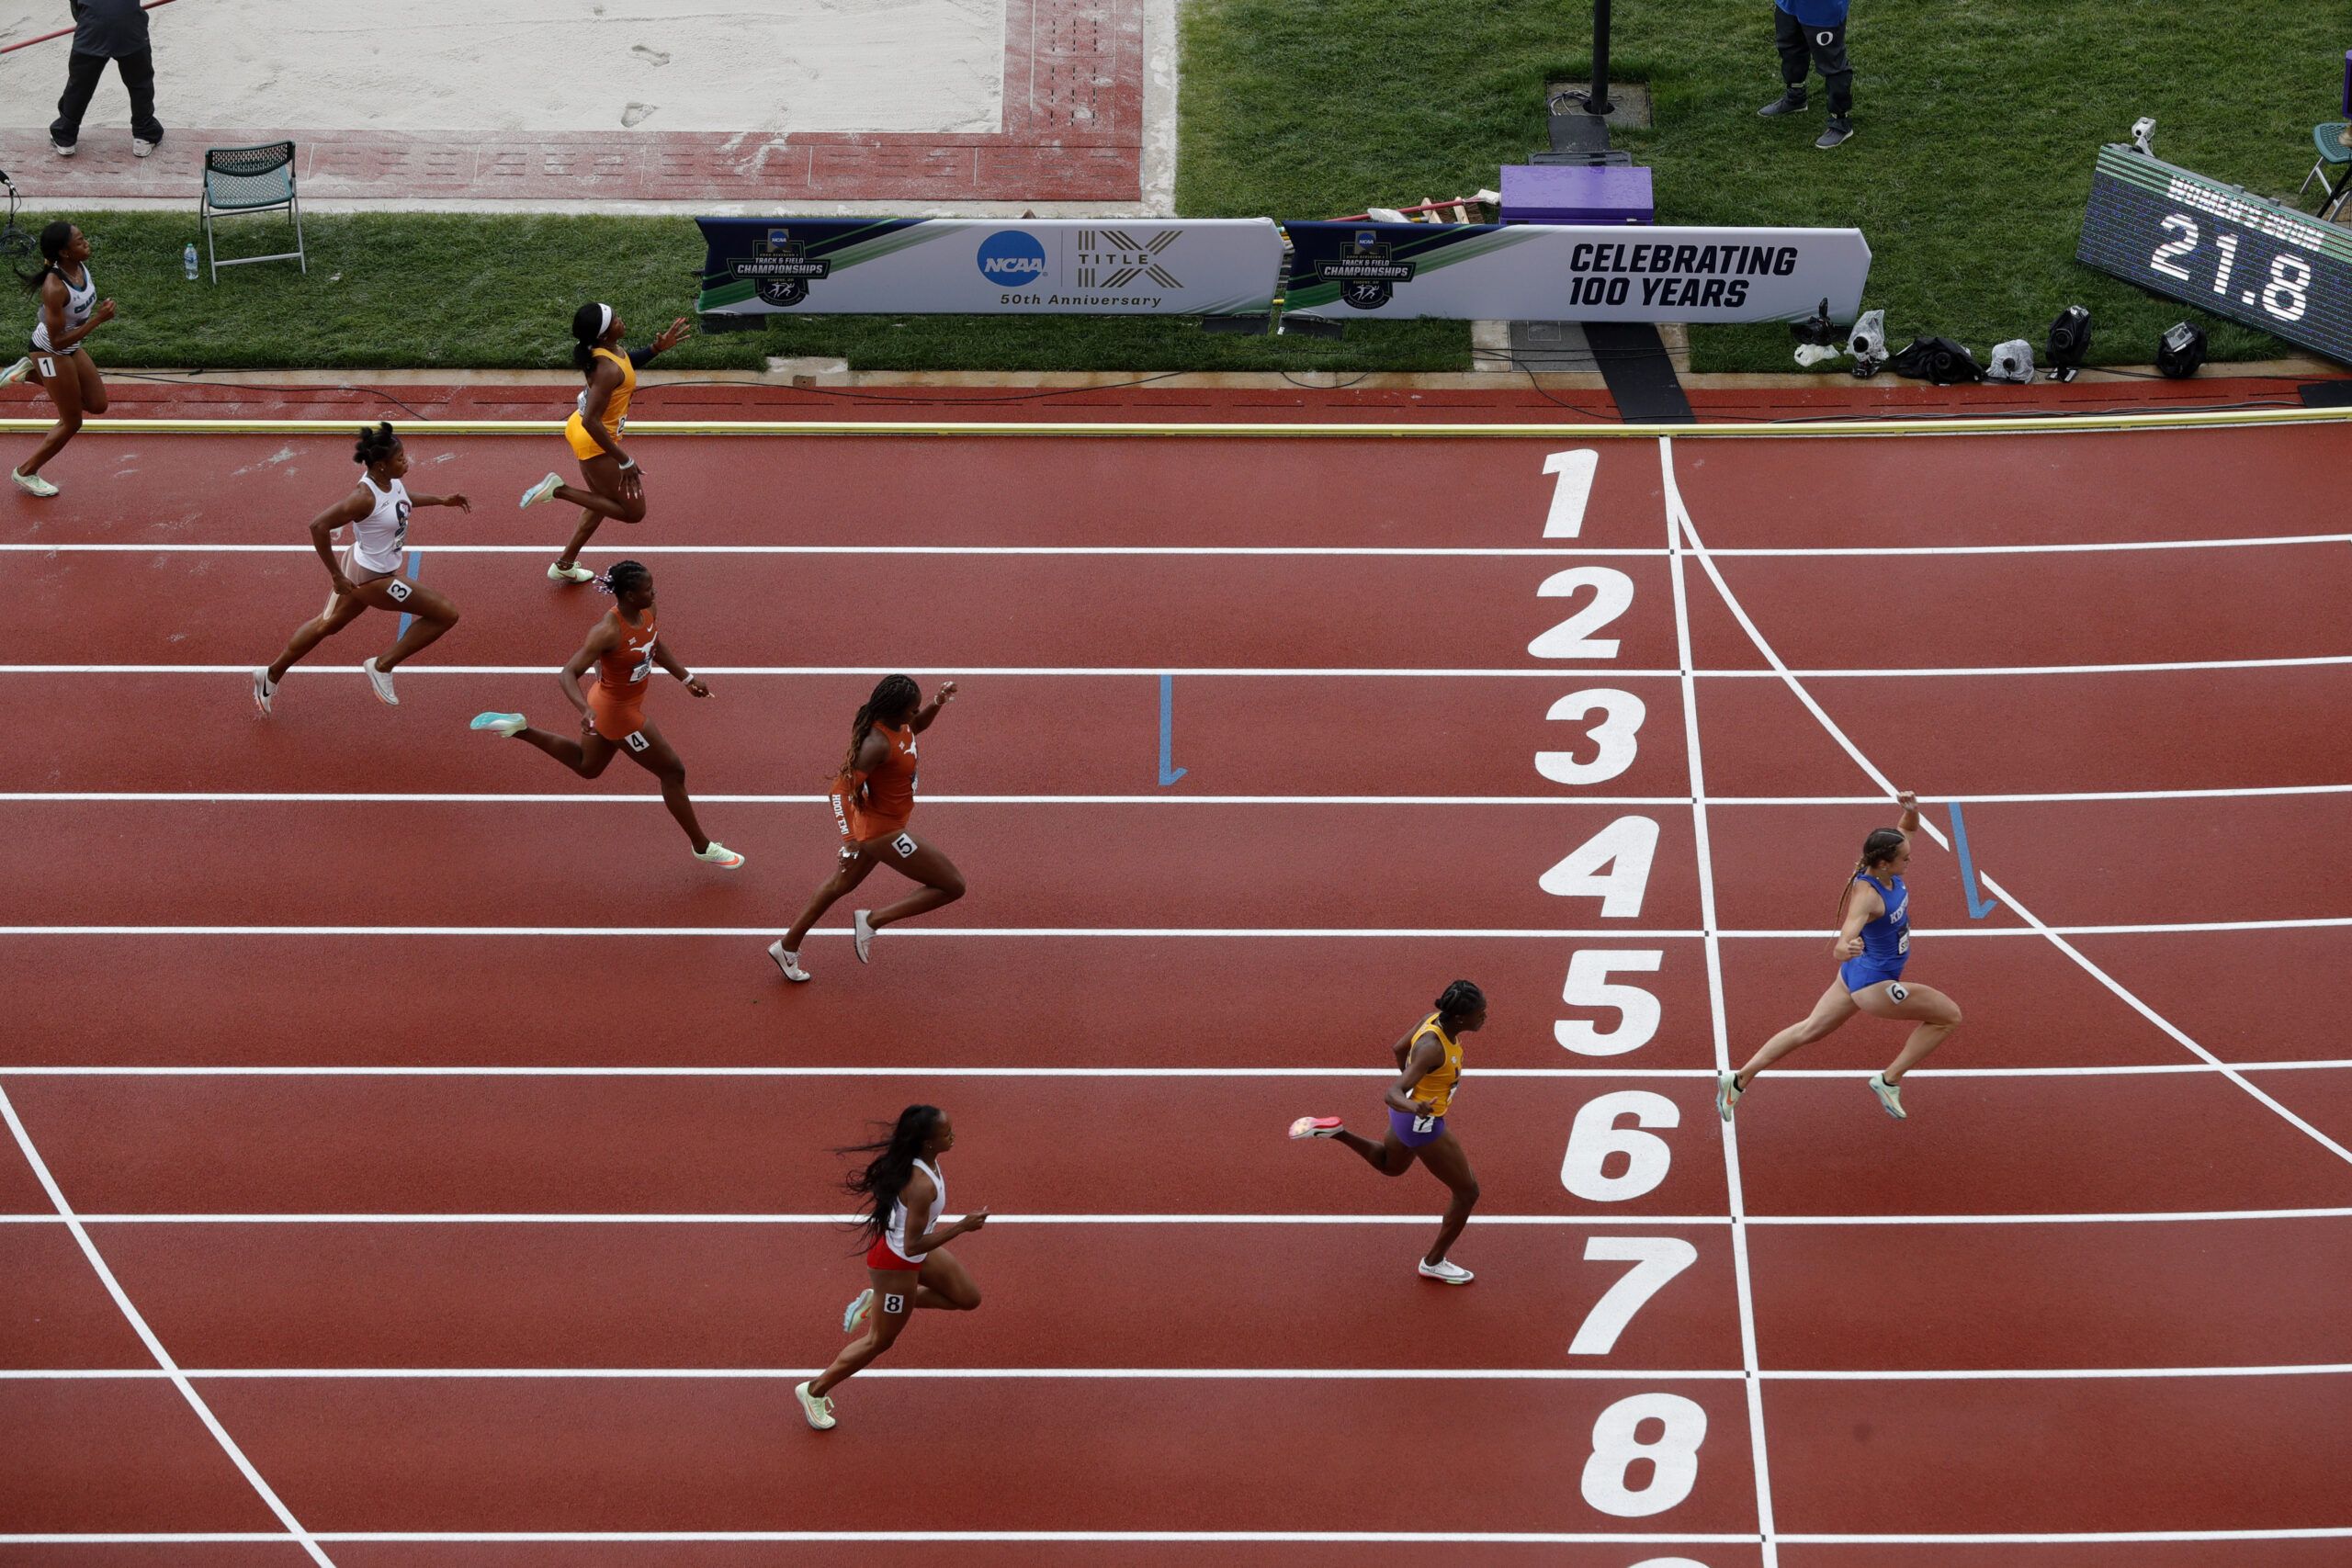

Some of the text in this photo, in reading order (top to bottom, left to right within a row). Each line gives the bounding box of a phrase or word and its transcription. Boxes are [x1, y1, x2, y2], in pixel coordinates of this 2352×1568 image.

[737, 265, 823, 274] CHAMPIONSHIPS
[984, 257, 1044, 273] NCAA
[1078, 254, 1149, 265] TITLE
[1569, 243, 1798, 276] CELEBRATING
[2150, 213, 2312, 321] 21.8
[1324, 266, 1408, 276] CHAMPIONSHIPS
[1000, 294, 1162, 309] 50th Anniversary
[1569, 276, 1750, 308] 100 YEARS
[42, 358, 51, 376] 1
[1543, 449, 1599, 537] 1
[390, 583, 408, 599] 3
[1528, 567, 1634, 658] 2
[631, 733, 646, 749] 4
[1535, 689, 1645, 784] 3
[831, 794, 844, 818] HOOK
[896, 837, 912, 854] 5
[1539, 816, 1659, 917] 4
[1555, 950, 1663, 1055] 5
[1891, 985, 1905, 1001] 6
[1418, 1116, 1430, 1131] 7
[1561, 1090, 1679, 1201] 6
[887, 1296, 900, 1312] 8
[1568, 1237, 1697, 1354] 7
[1581, 1393, 1707, 1517] 8
